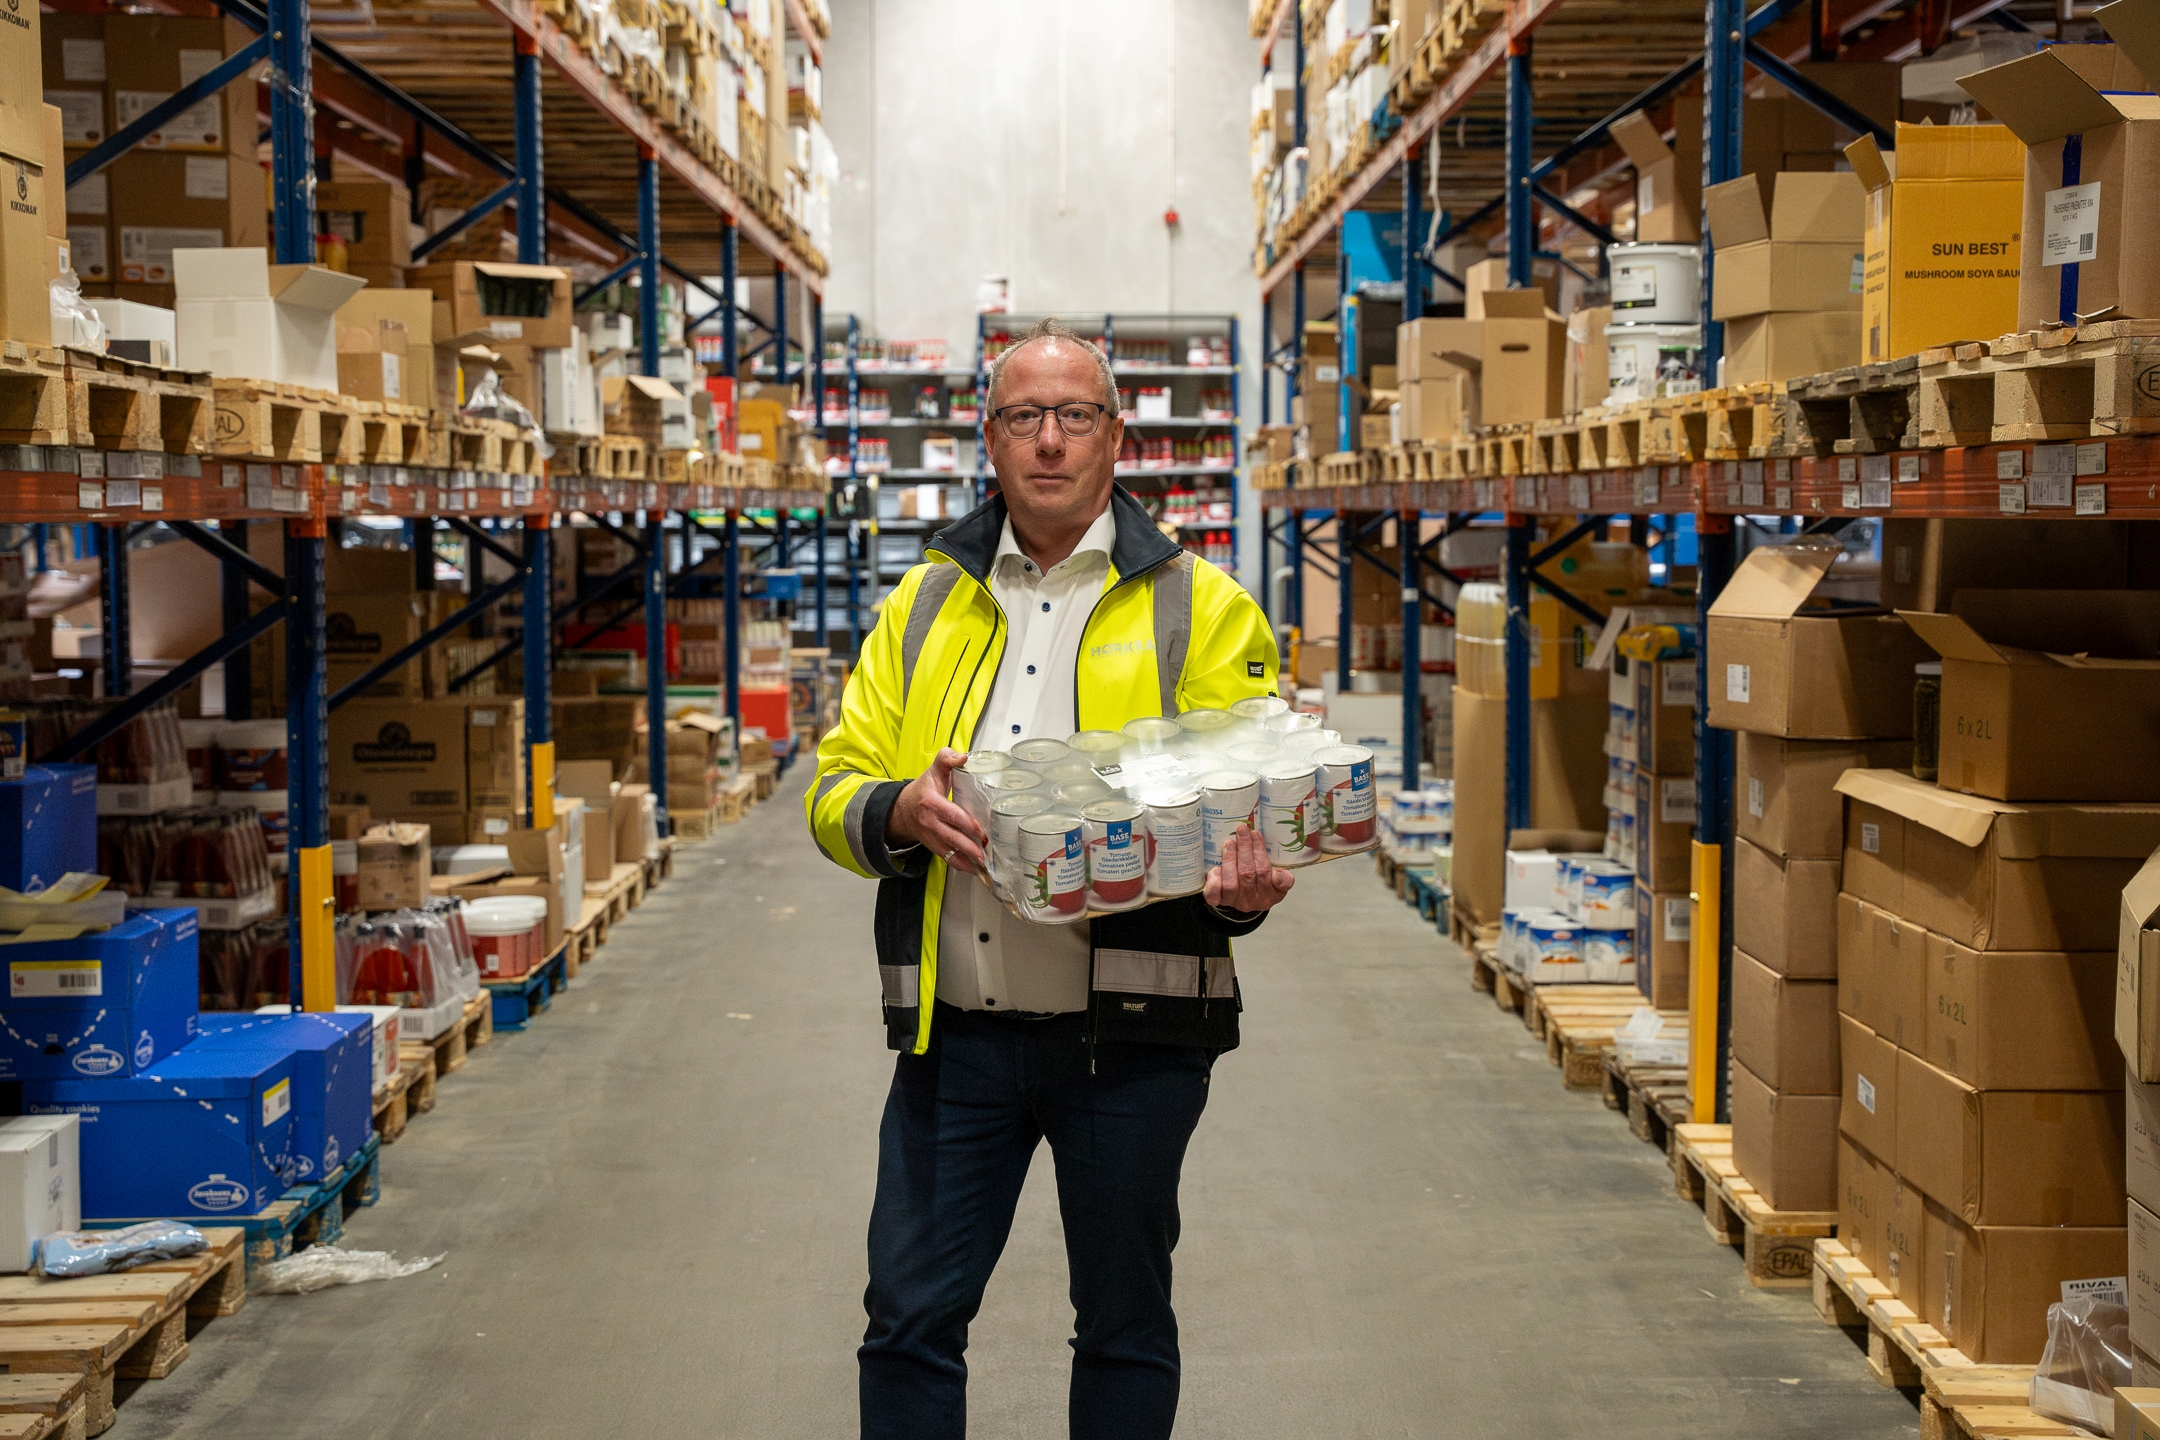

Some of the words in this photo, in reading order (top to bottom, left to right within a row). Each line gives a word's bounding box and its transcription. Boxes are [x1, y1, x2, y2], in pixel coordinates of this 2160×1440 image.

[1932, 243, 1964, 256] SUN
[1968, 242, 2009, 255] BEST
[1905, 269, 1965, 279] MUSHROOM
[1967, 269, 1995, 278] SOYA
[1109, 832, 1130, 842] BASE
[1772, 1251, 1812, 1271] EPAL
[2069, 1281, 2119, 1290] RIVAL
